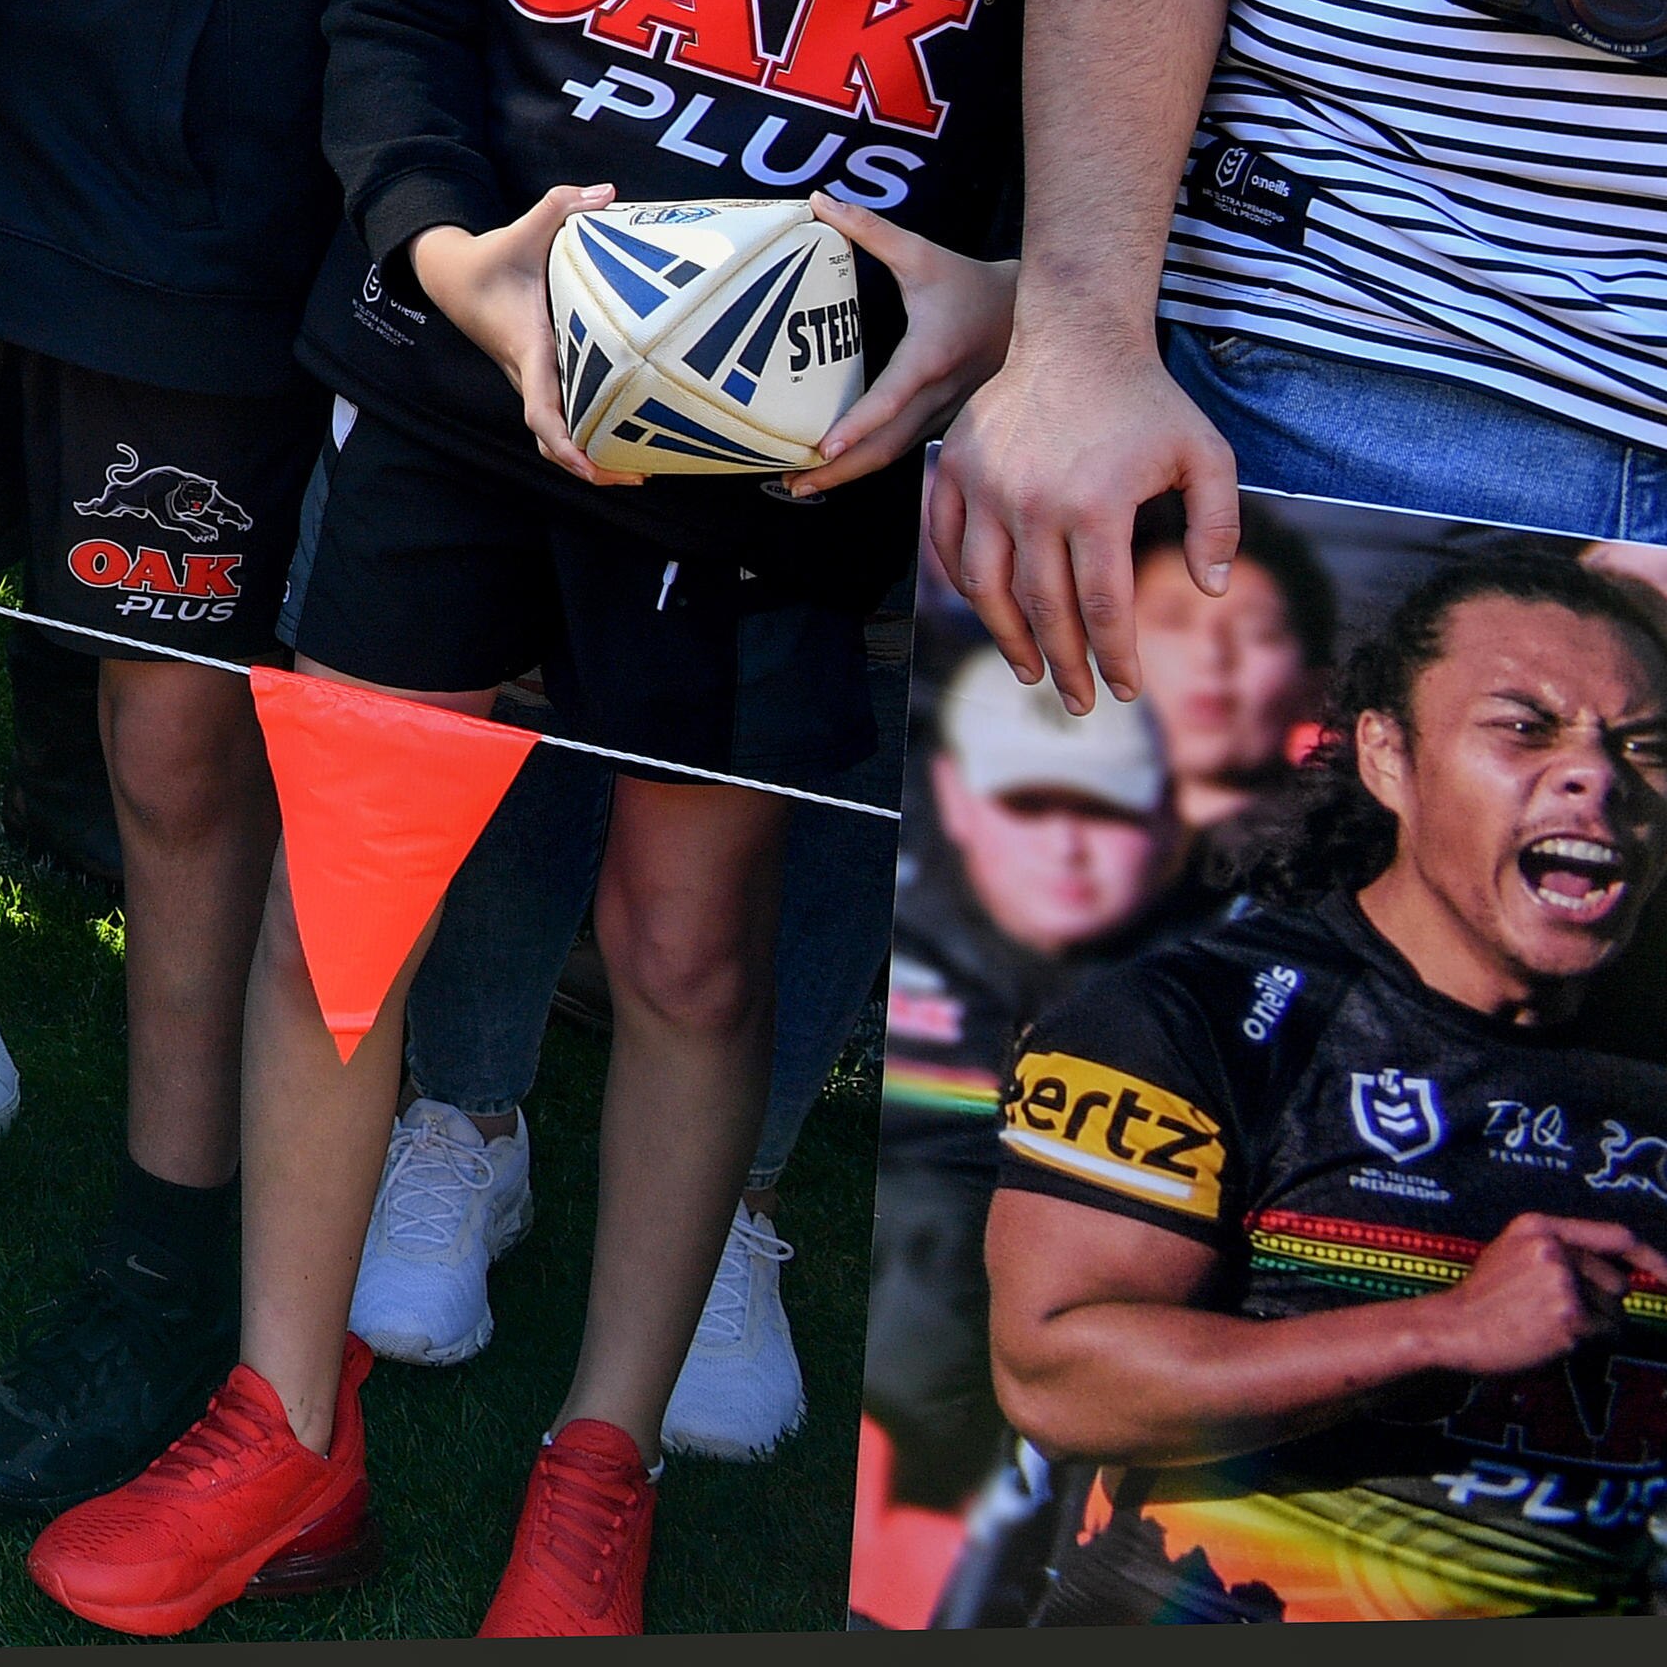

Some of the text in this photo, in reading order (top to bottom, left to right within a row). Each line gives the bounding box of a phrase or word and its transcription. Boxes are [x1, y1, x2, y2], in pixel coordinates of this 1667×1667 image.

[563, 65, 926, 210] PLUS
[787, 297, 862, 373] STEED
[68, 538, 243, 599] OAK
[115, 595, 238, 623] PLUS
[1010, 1076, 1214, 1181] ertz
[1349, 1174, 1452, 1203] PREMIERSHIP
[1489, 1148, 1572, 1171] PENRITH
